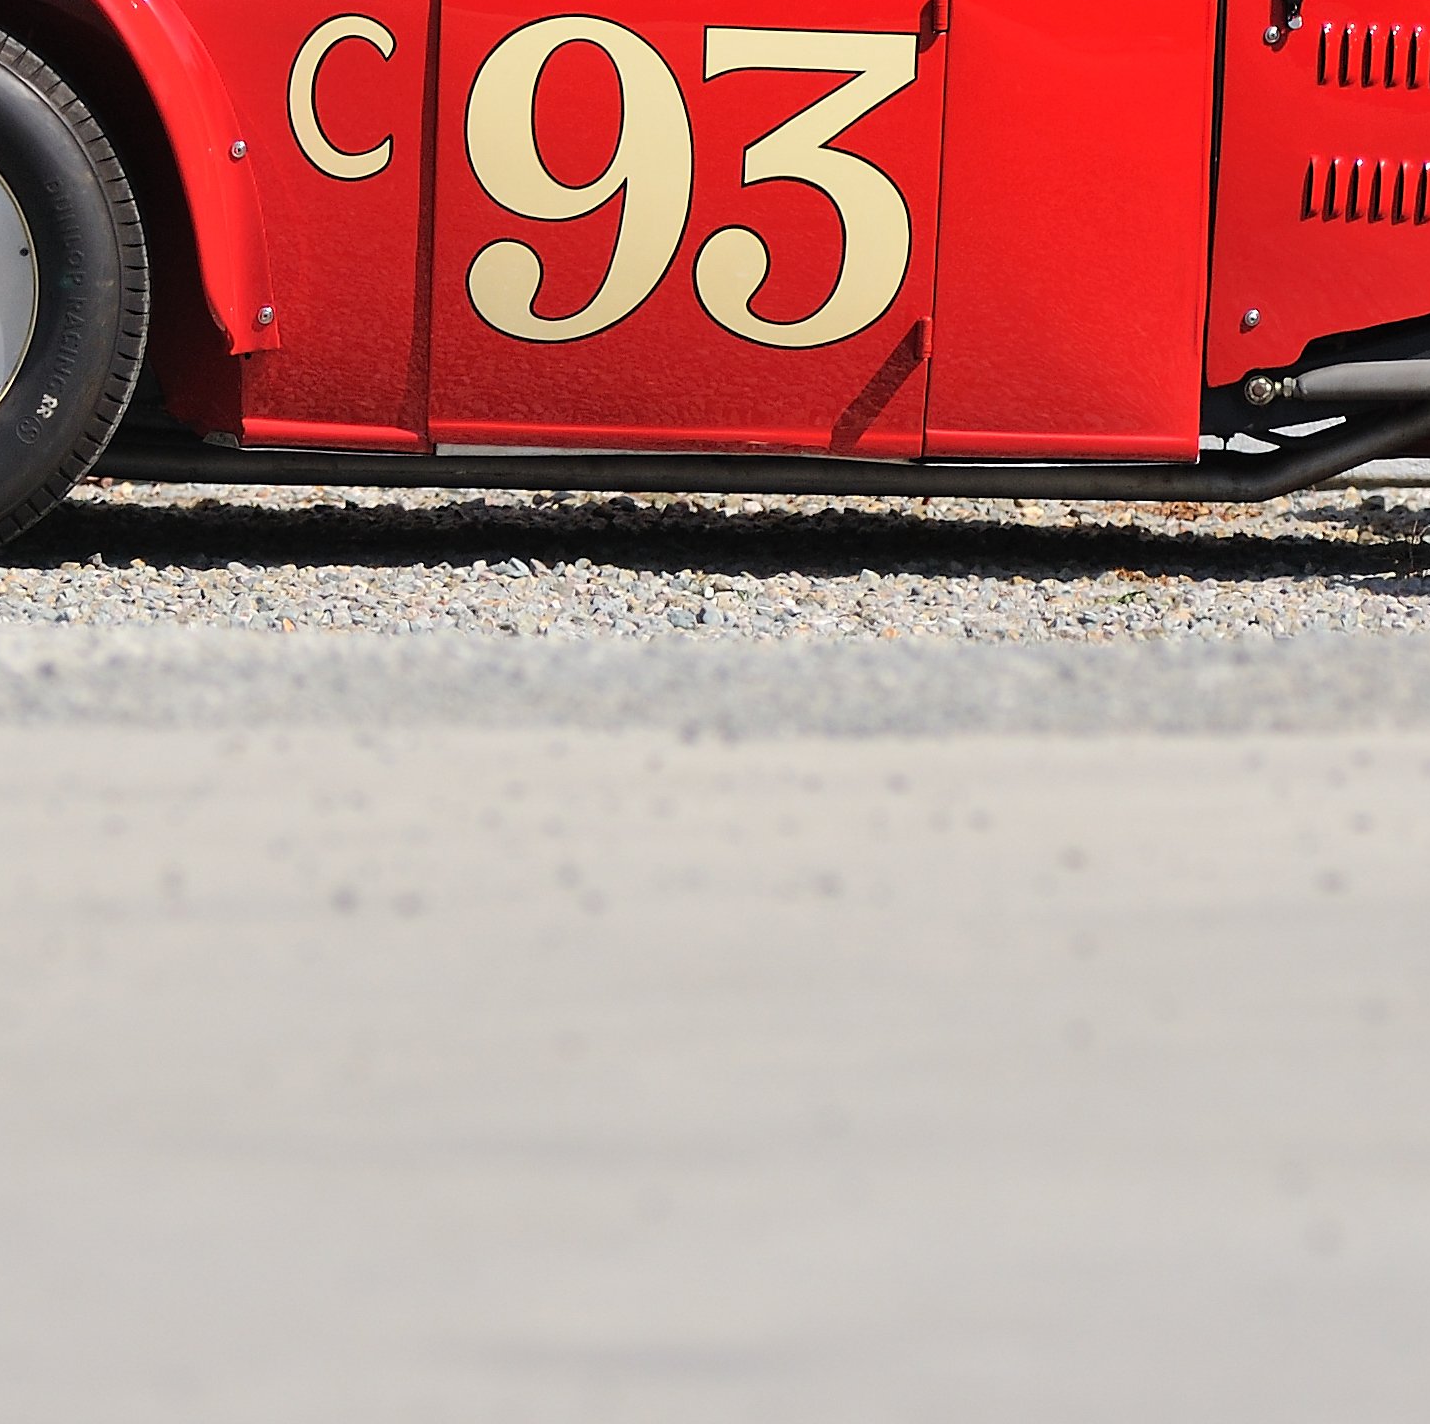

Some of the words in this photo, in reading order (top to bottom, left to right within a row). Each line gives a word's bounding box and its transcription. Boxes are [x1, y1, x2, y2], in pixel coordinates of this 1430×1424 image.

[287, 13, 397, 182] C
[464, 14, 920, 349] 93
[46, 295, 87, 390] RACING
[36, 393, 59, 419] RR
